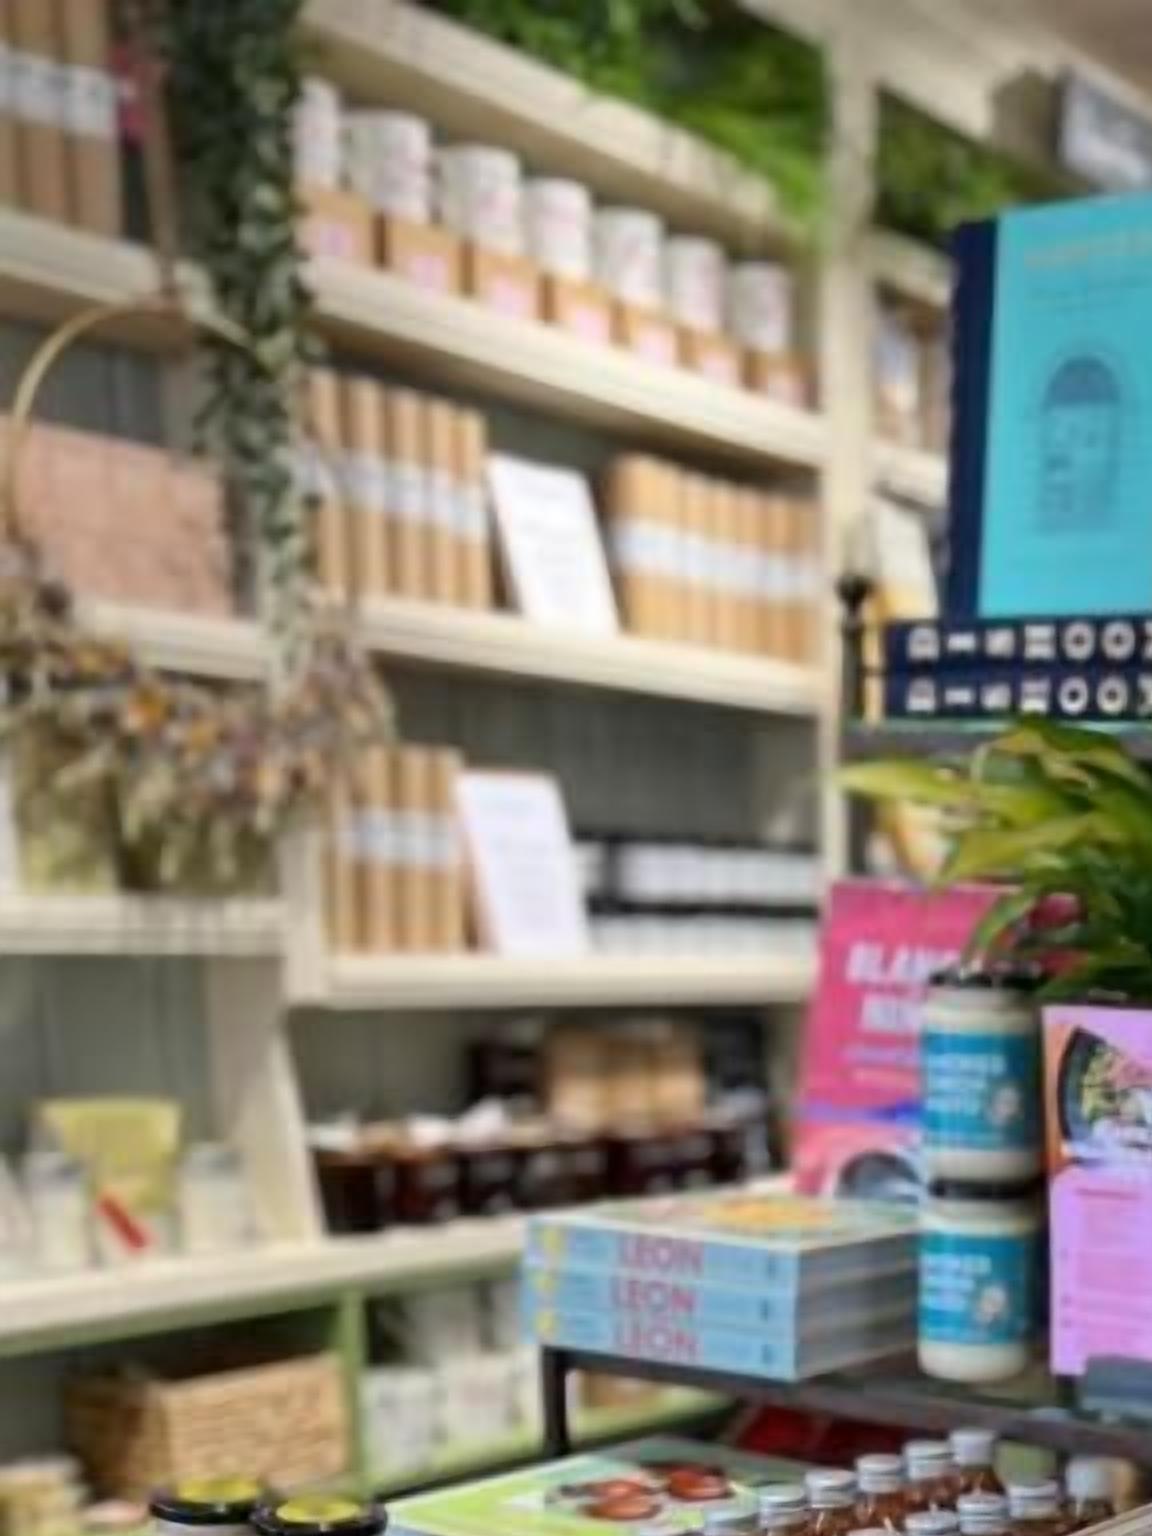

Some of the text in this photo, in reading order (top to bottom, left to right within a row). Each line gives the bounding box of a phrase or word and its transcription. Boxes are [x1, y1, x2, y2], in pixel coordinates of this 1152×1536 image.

[620, 1231, 703, 1272] LEON
[612, 1277, 697, 1314] LEON
[613, 1323, 699, 1362] LEON
